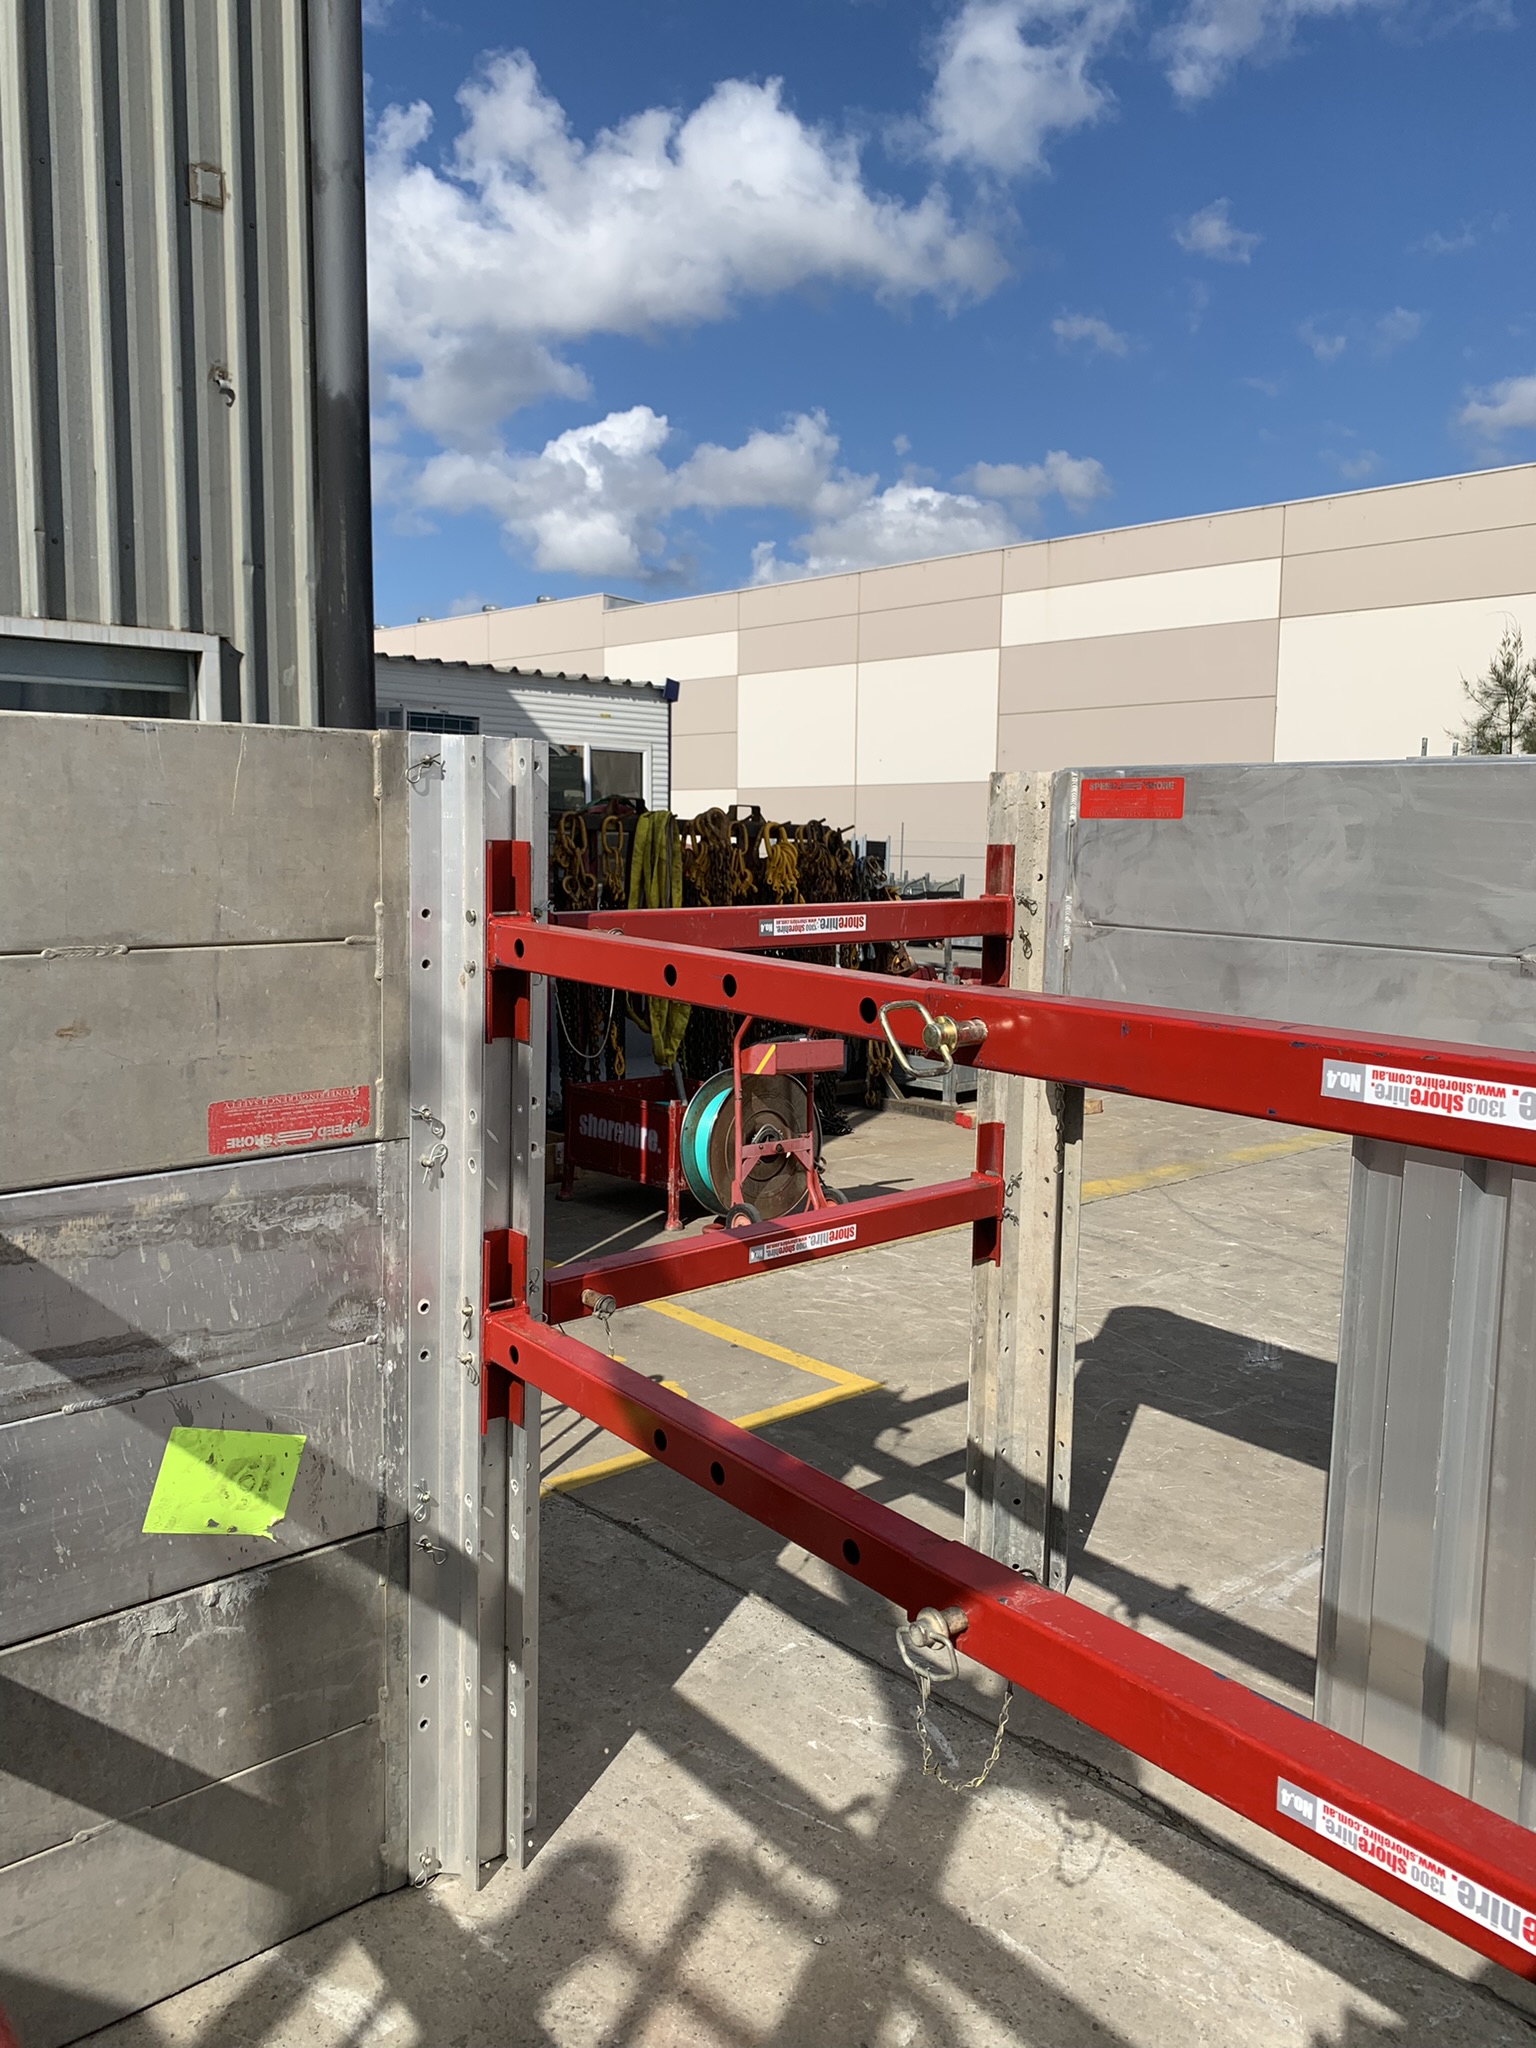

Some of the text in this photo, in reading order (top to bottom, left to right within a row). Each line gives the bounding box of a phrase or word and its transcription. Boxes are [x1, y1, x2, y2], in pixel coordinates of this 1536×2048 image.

[818, 916, 865, 930] shorehire.
[1326, 1070, 1362, 1093] No.4
[1372, 1069, 1506, 1098] www.shorehire.com.au
[1371, 1082, 1464, 1114] shorehire.
[1468, 1096, 1507, 1118] 1300
[226, 1133, 273, 1149] SHORE
[579, 1112, 662, 1154] shorehire.
[808, 1226, 855, 1246] shorehire.
[1281, 1788, 1313, 1821] No.4
[1322, 1815, 1446, 1896] 1300 shorehire.
[1323, 1804, 1446, 1880] www.shorehire.com.au
